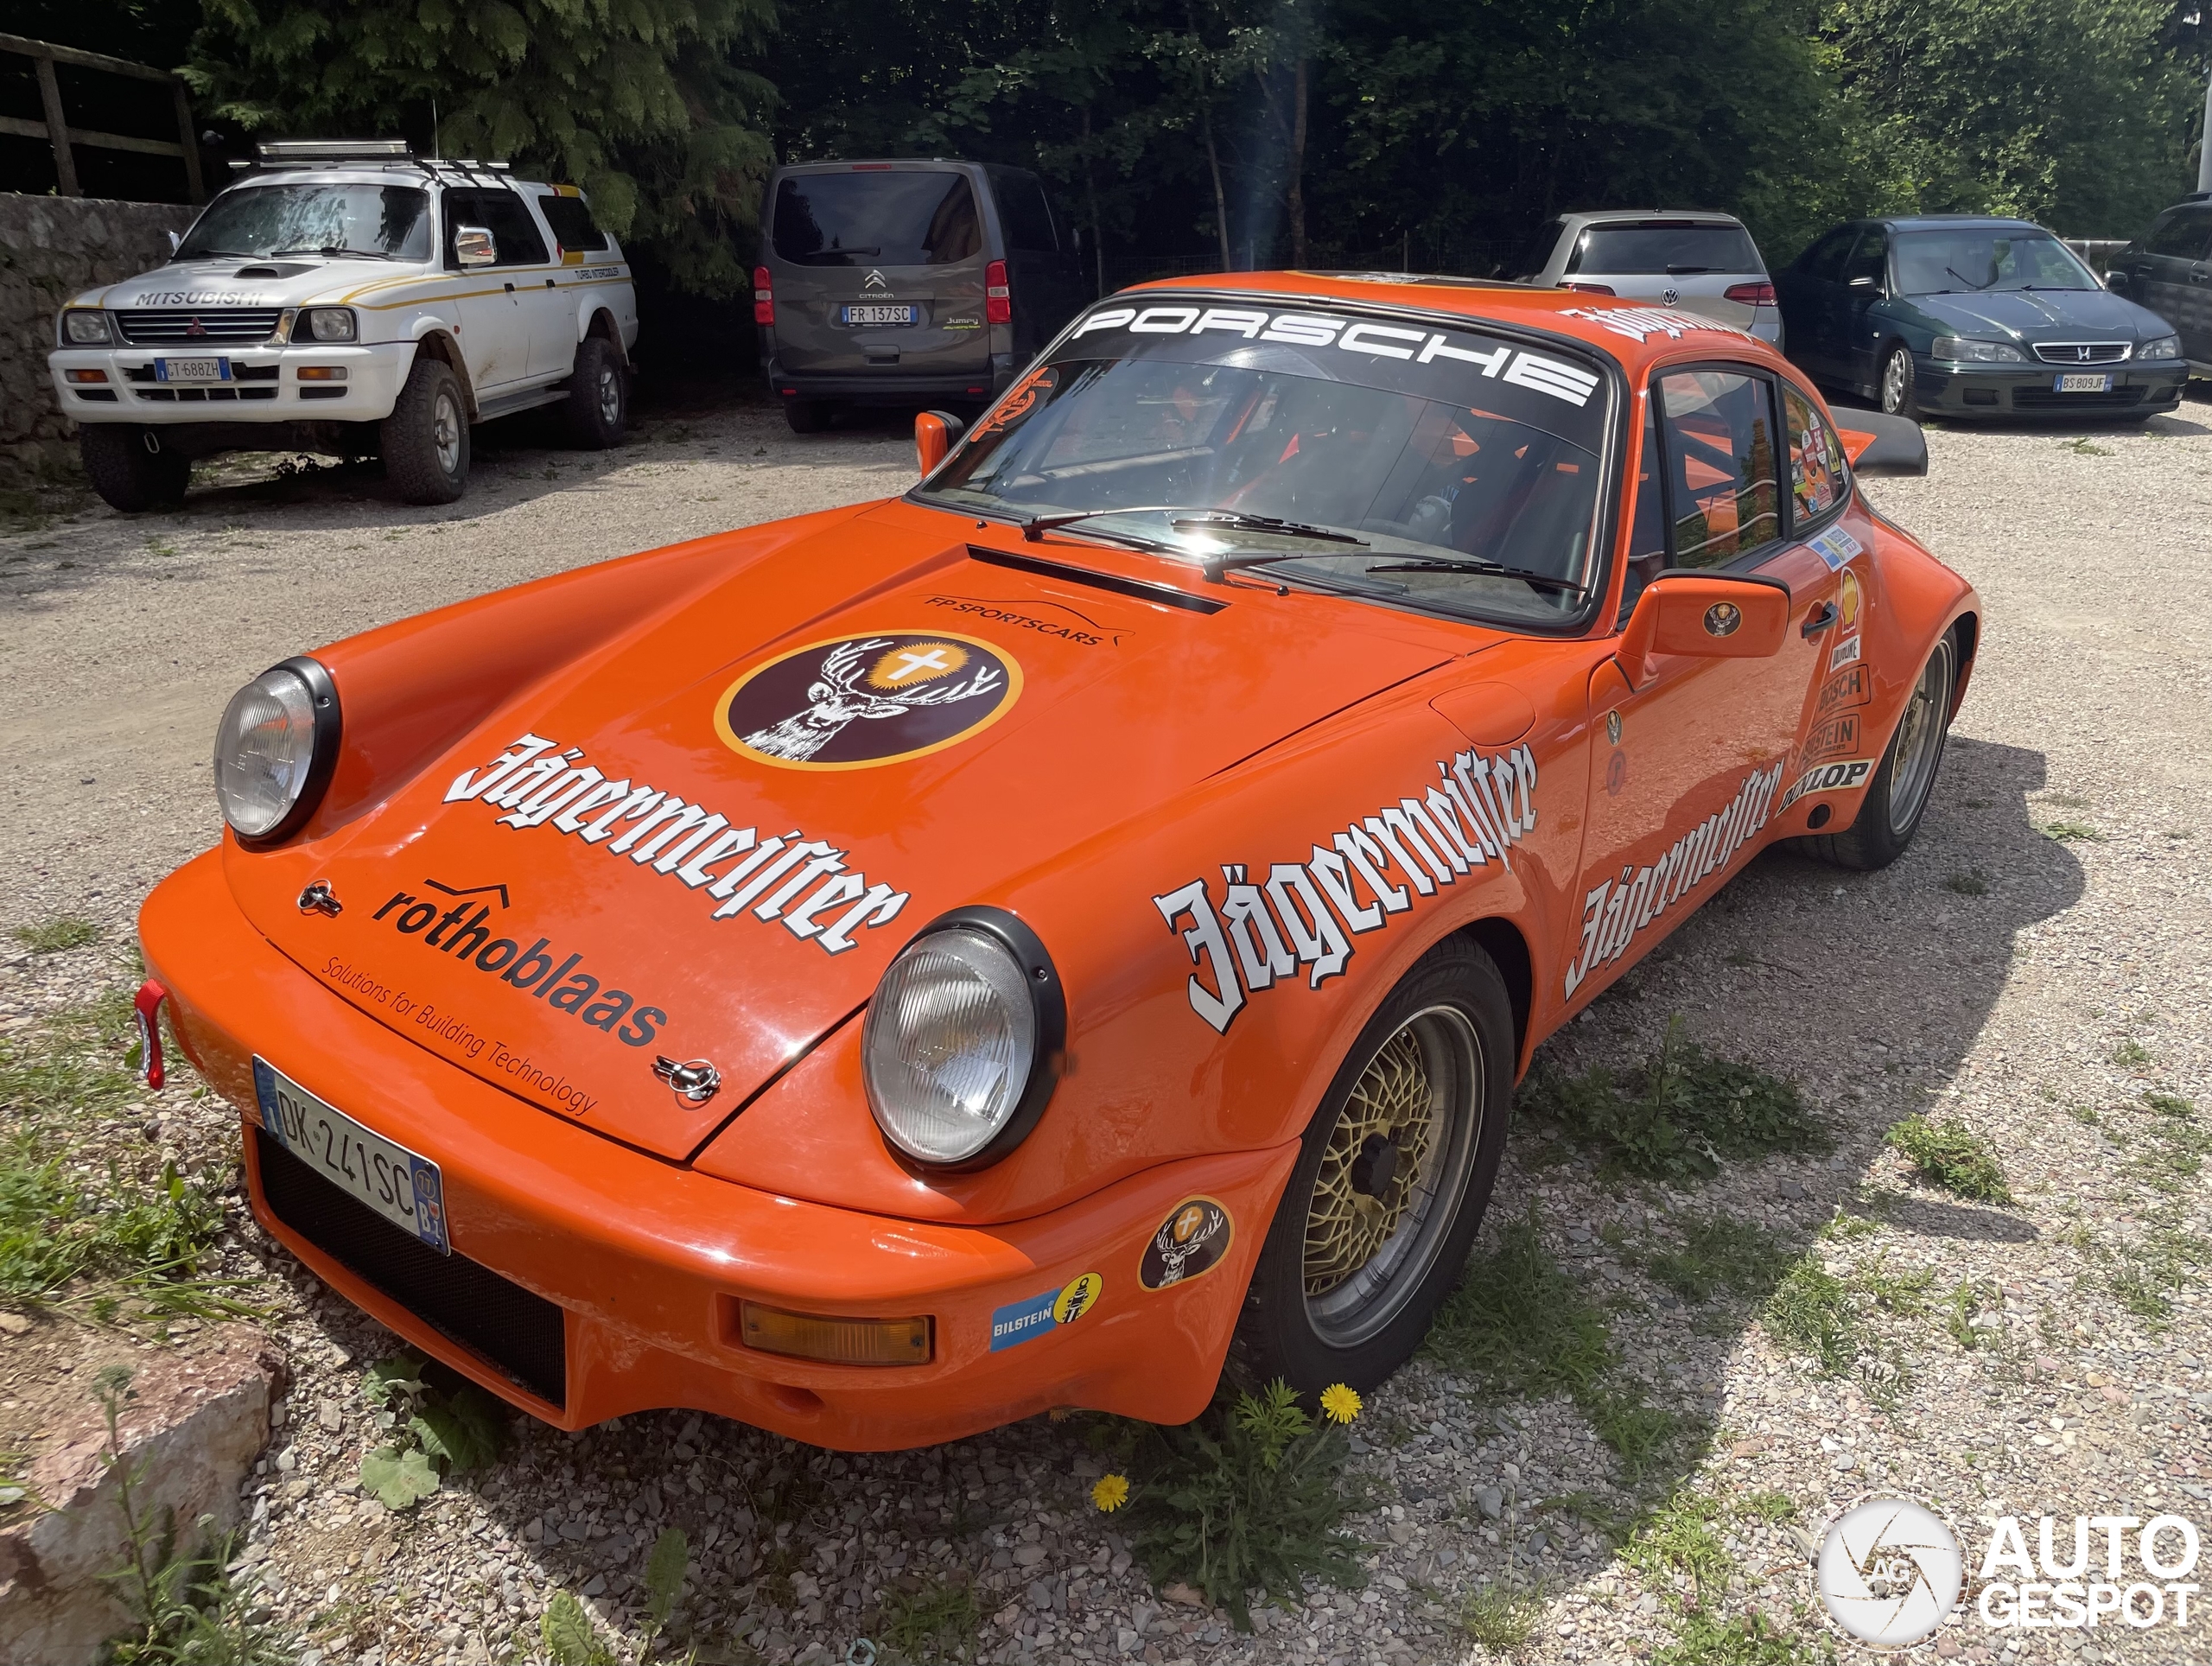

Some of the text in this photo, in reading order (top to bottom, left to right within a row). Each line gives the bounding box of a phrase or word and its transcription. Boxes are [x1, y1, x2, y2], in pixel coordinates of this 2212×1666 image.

[135, 291, 264, 306] MITSUBISHI
[1071, 308, 1600, 408] PORSCHE
[1818, 670, 1861, 712] BOSCH
[1777, 762, 1869, 815] DUNLOP
[442, 732, 911, 956] Jägermeister
[1151, 742, 1538, 1035] Jägermeister
[371, 892, 668, 1046] rothoblaas
[321, 957, 599, 1117] Solutions for Building Technology
[994, 1307, 1052, 1338] BILSTEIN
